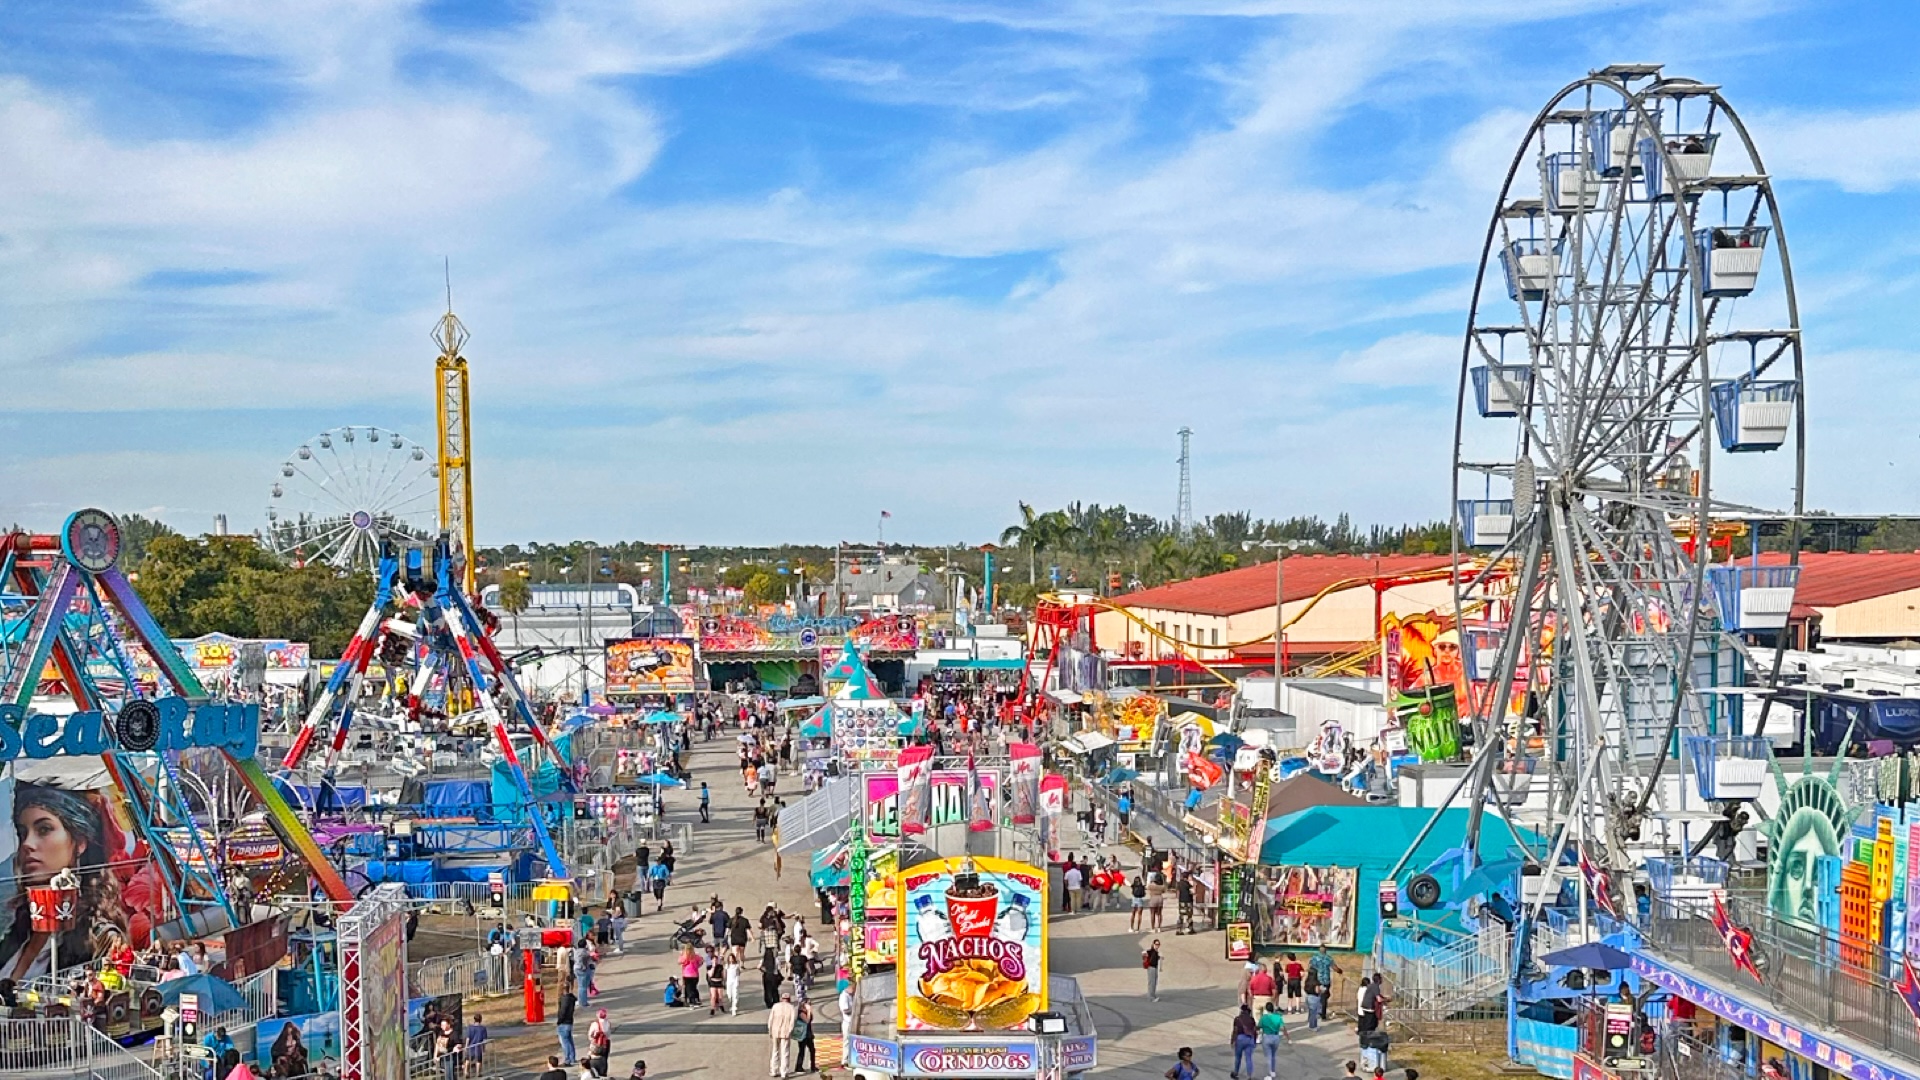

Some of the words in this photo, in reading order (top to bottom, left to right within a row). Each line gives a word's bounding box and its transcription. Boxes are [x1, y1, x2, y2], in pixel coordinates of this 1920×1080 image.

[0, 703, 106, 761] Sea
[154, 698, 259, 760] Ray
[231, 844, 279, 859] TORNADO
[920, 936, 1024, 980] NACHOS
[914, 1049, 1030, 1073] CORNDOGS
